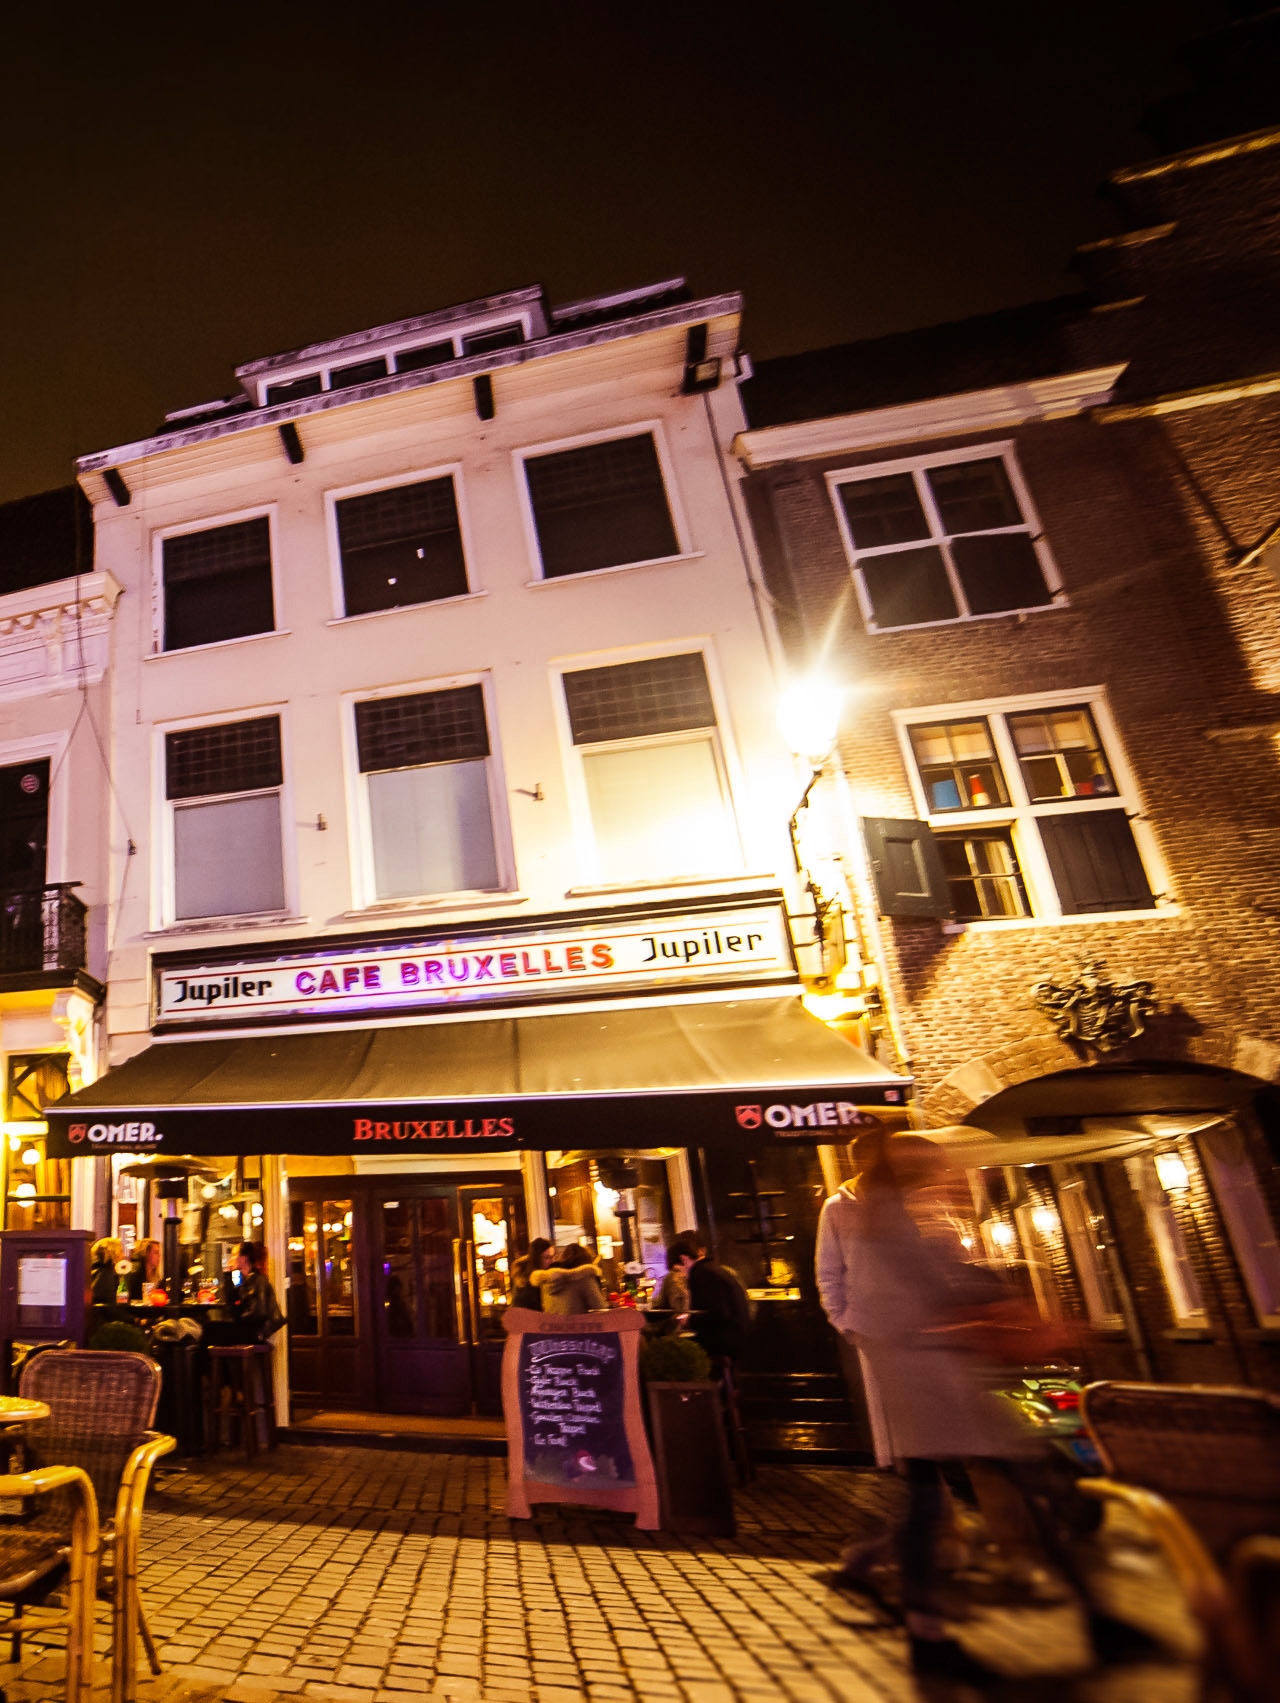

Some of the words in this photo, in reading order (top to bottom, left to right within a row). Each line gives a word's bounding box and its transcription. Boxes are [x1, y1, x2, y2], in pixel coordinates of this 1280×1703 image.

[641, 931, 763, 963] Jupiler
[296, 965, 381, 995] CAFE
[400, 943, 615, 985] BRUXELLES
[173, 976, 273, 1005] Jupiler
